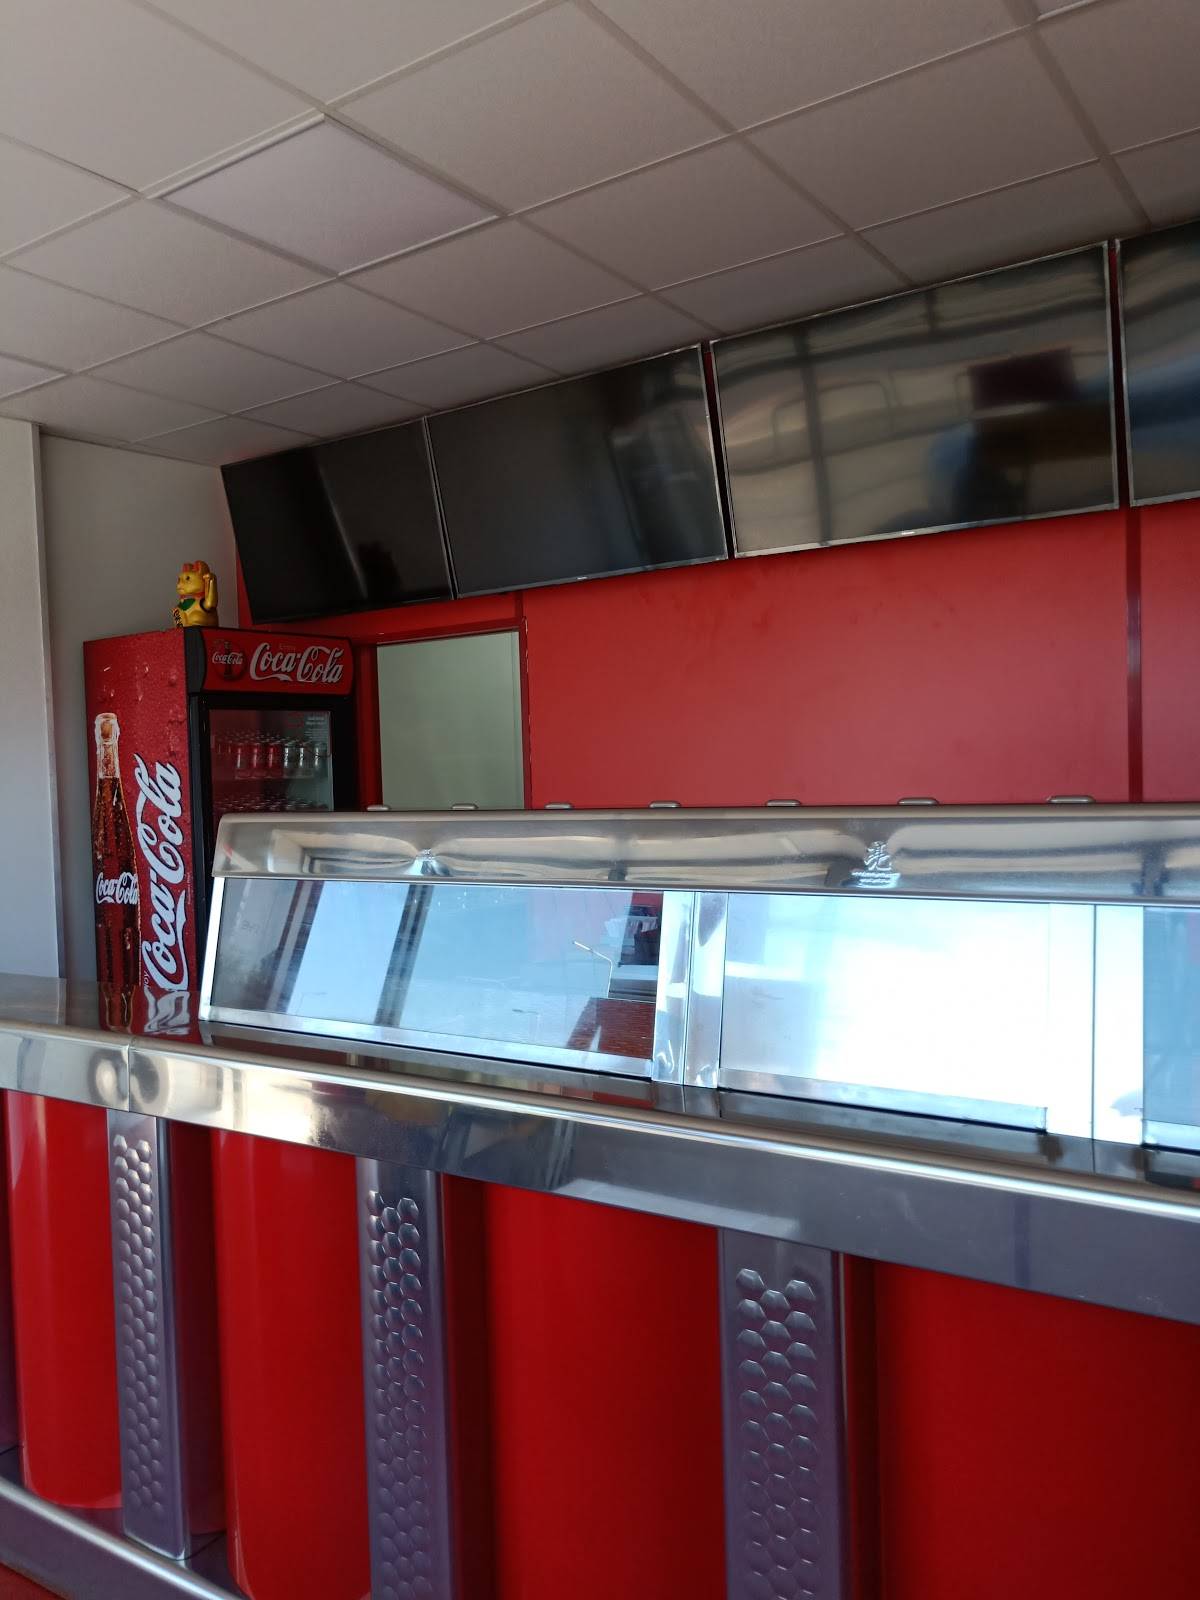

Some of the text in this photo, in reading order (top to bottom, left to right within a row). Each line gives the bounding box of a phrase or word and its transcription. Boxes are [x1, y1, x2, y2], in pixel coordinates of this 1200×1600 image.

[250, 643, 344, 683] Coca-Cola
[96, 872, 139, 905] Coca-Cola
[133, 753, 189, 991] Coca-Cola
